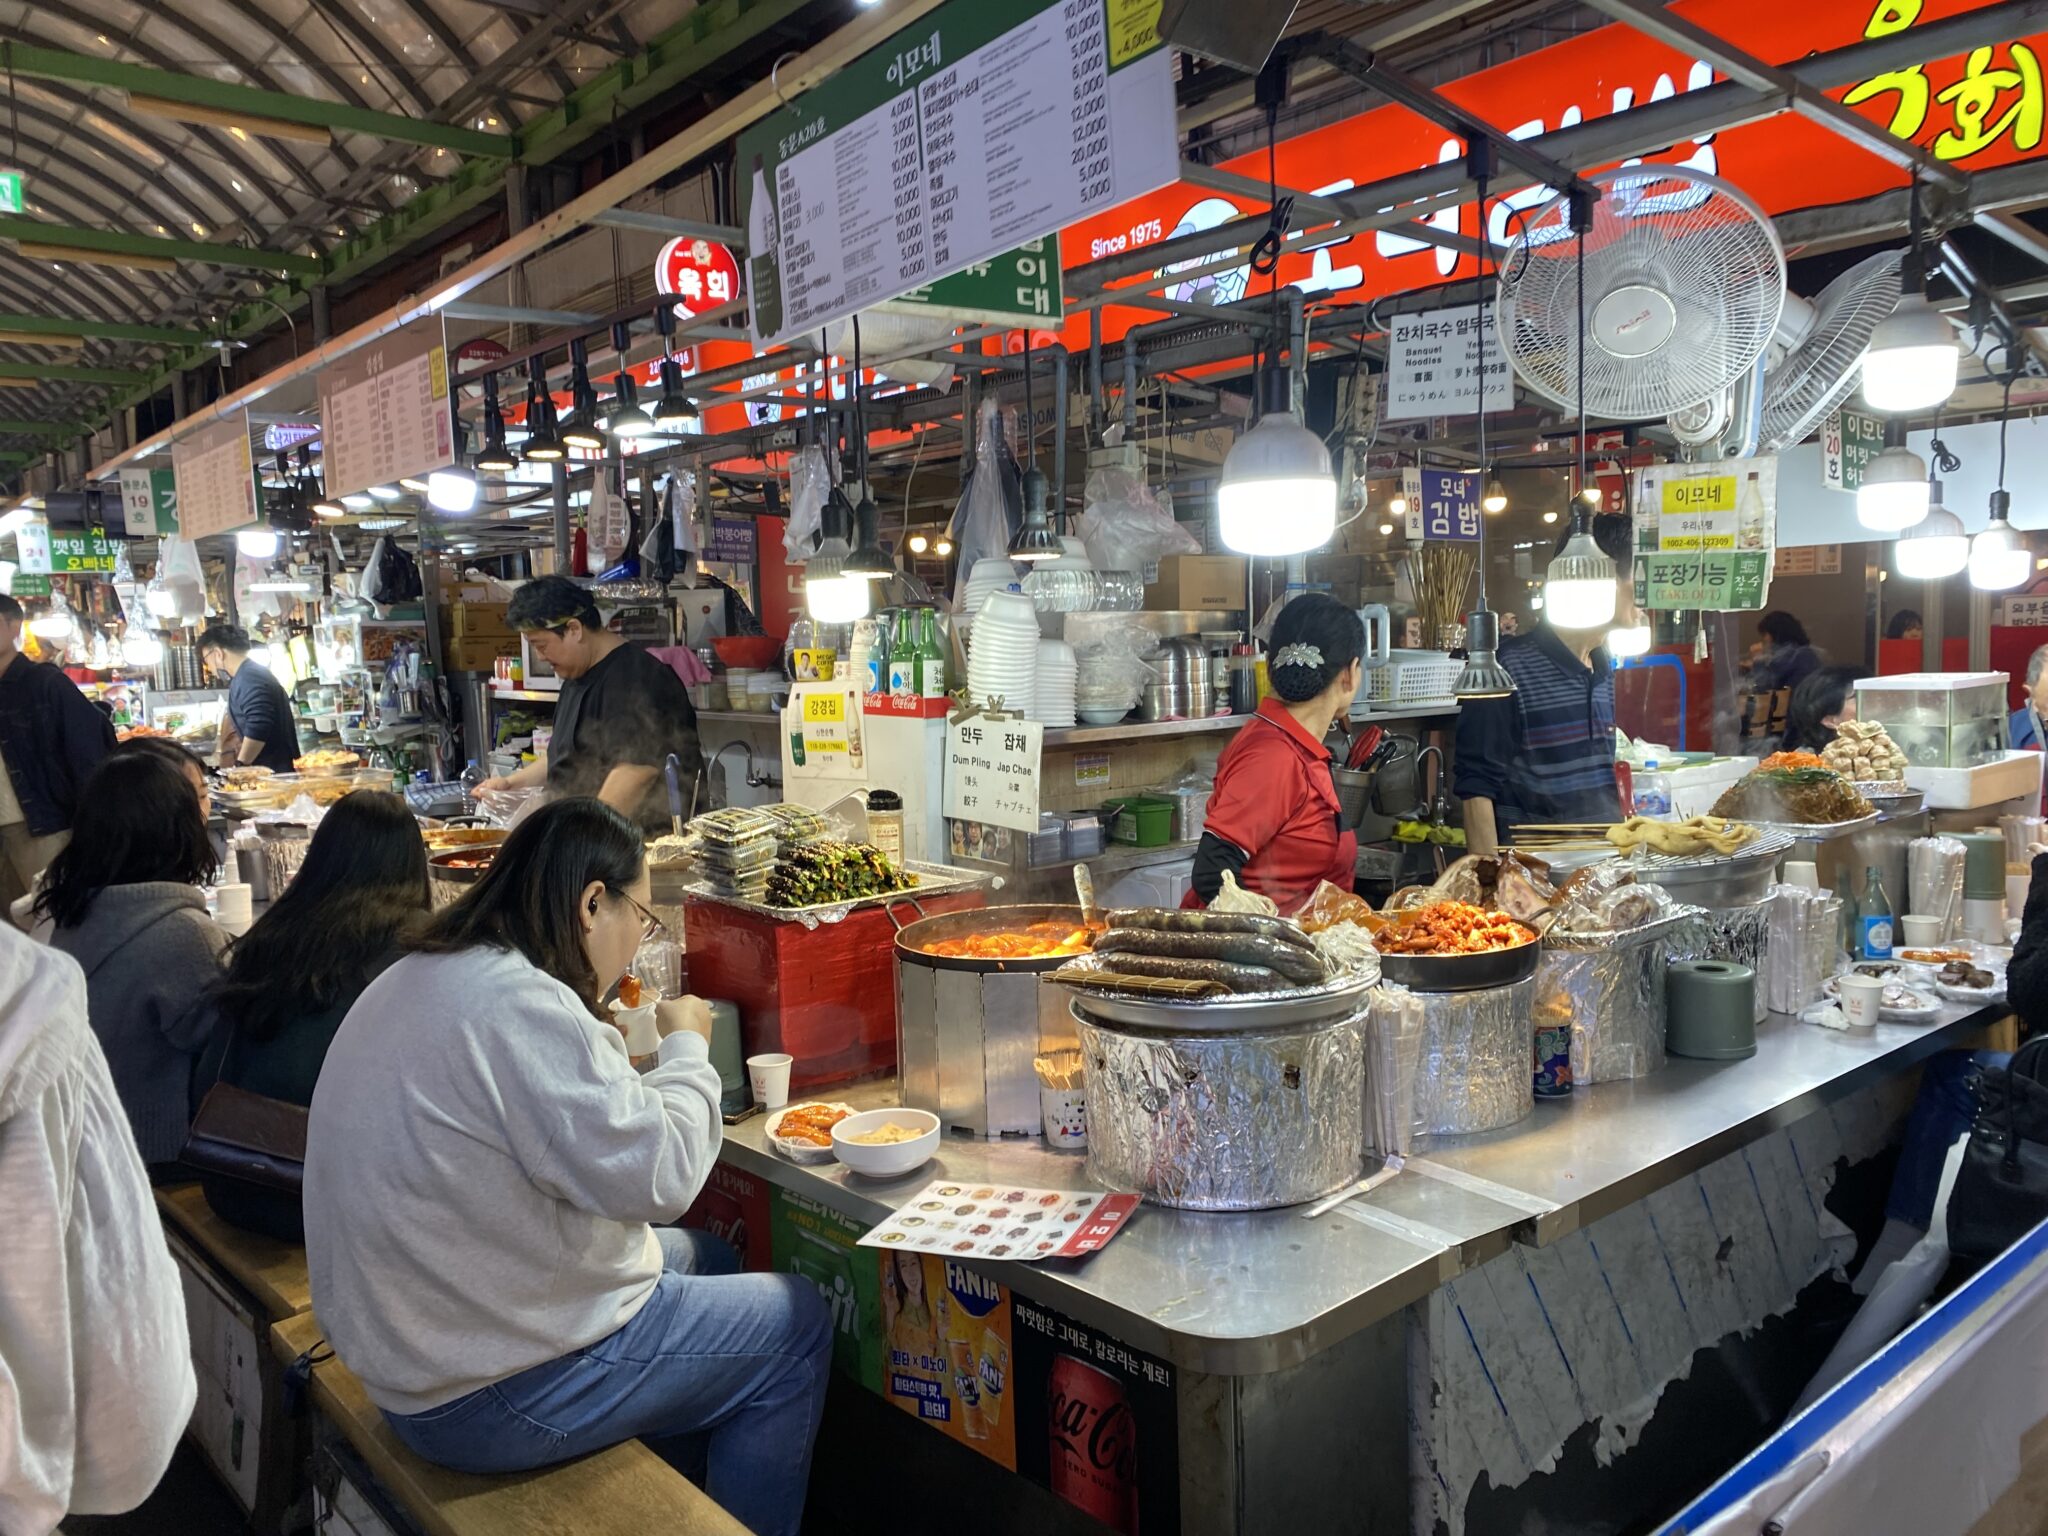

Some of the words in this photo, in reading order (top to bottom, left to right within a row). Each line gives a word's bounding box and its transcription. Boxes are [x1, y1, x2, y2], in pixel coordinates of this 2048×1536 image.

[1065, 10, 1100, 42] 10,000
[1071, 31, 1101, 60] 5,000
[886, 30, 941, 87] 이모네
[891, 95, 913, 118] 4,000
[1071, 94, 1105, 123] 12,000
[1072, 115, 1107, 143] 12,000
[894, 132, 916, 154] 7,000
[1071, 136, 1108, 166] 20,000
[892, 151, 917, 172] 10,000
[1079, 156, 1109, 183] 5,000
[893, 169, 918, 191] 12,000
[1080, 177, 1110, 203] 5,000
[894, 186, 919, 208] 10,000
[895, 204, 921, 227] 10,000
[896, 222, 922, 245] 10,000
[1091, 234, 1127, 258] Since
[1130, 218, 1162, 246] 1975
[901, 240, 923, 261] 5,000
[900, 257, 925, 280] 10,000
[1396, 322, 1452, 343] 잔치국수
[1456, 314, 1497, 335] 열무국
[1405, 346, 1442, 357] Banquet
[1405, 357, 1442, 367] Noodles
[1826, 434, 1840, 456] 20
[1846, 444, 1880, 465] 머릿
[1828, 458, 1840, 480] 호
[1440, 478, 1465, 500] 모녀
[1675, 485, 1721, 505] 이모네
[129, 495, 148, 508] 19
[1408, 496, 1420, 513] 19
[1431, 502, 1479, 536] 김밥
[52, 539, 86, 556] 깻잎
[66, 556, 116, 572] 오빠네
[1652, 562, 1728, 586] 포장가능
[811, 700, 836, 715] 강경집
[961, 727, 983, 745] 만두
[1004, 733, 1027, 753] 잡채
[952, 754, 970, 765] Dum
[971, 756, 991, 769] Pling
[996, 762, 1011, 774] Jap
[1012, 763, 1032, 776] Chae
[1016, 1303, 1056, 1337] 짜릿함은
[1058, 1322, 1093, 1355] 그대로,
[1095, 1338, 1139, 1376] 칼로리는
[1142, 1359, 1170, 1388] 제로!
[921, 1356, 947, 1374] 미노이
[928, 1384, 941, 1400] 맛,
